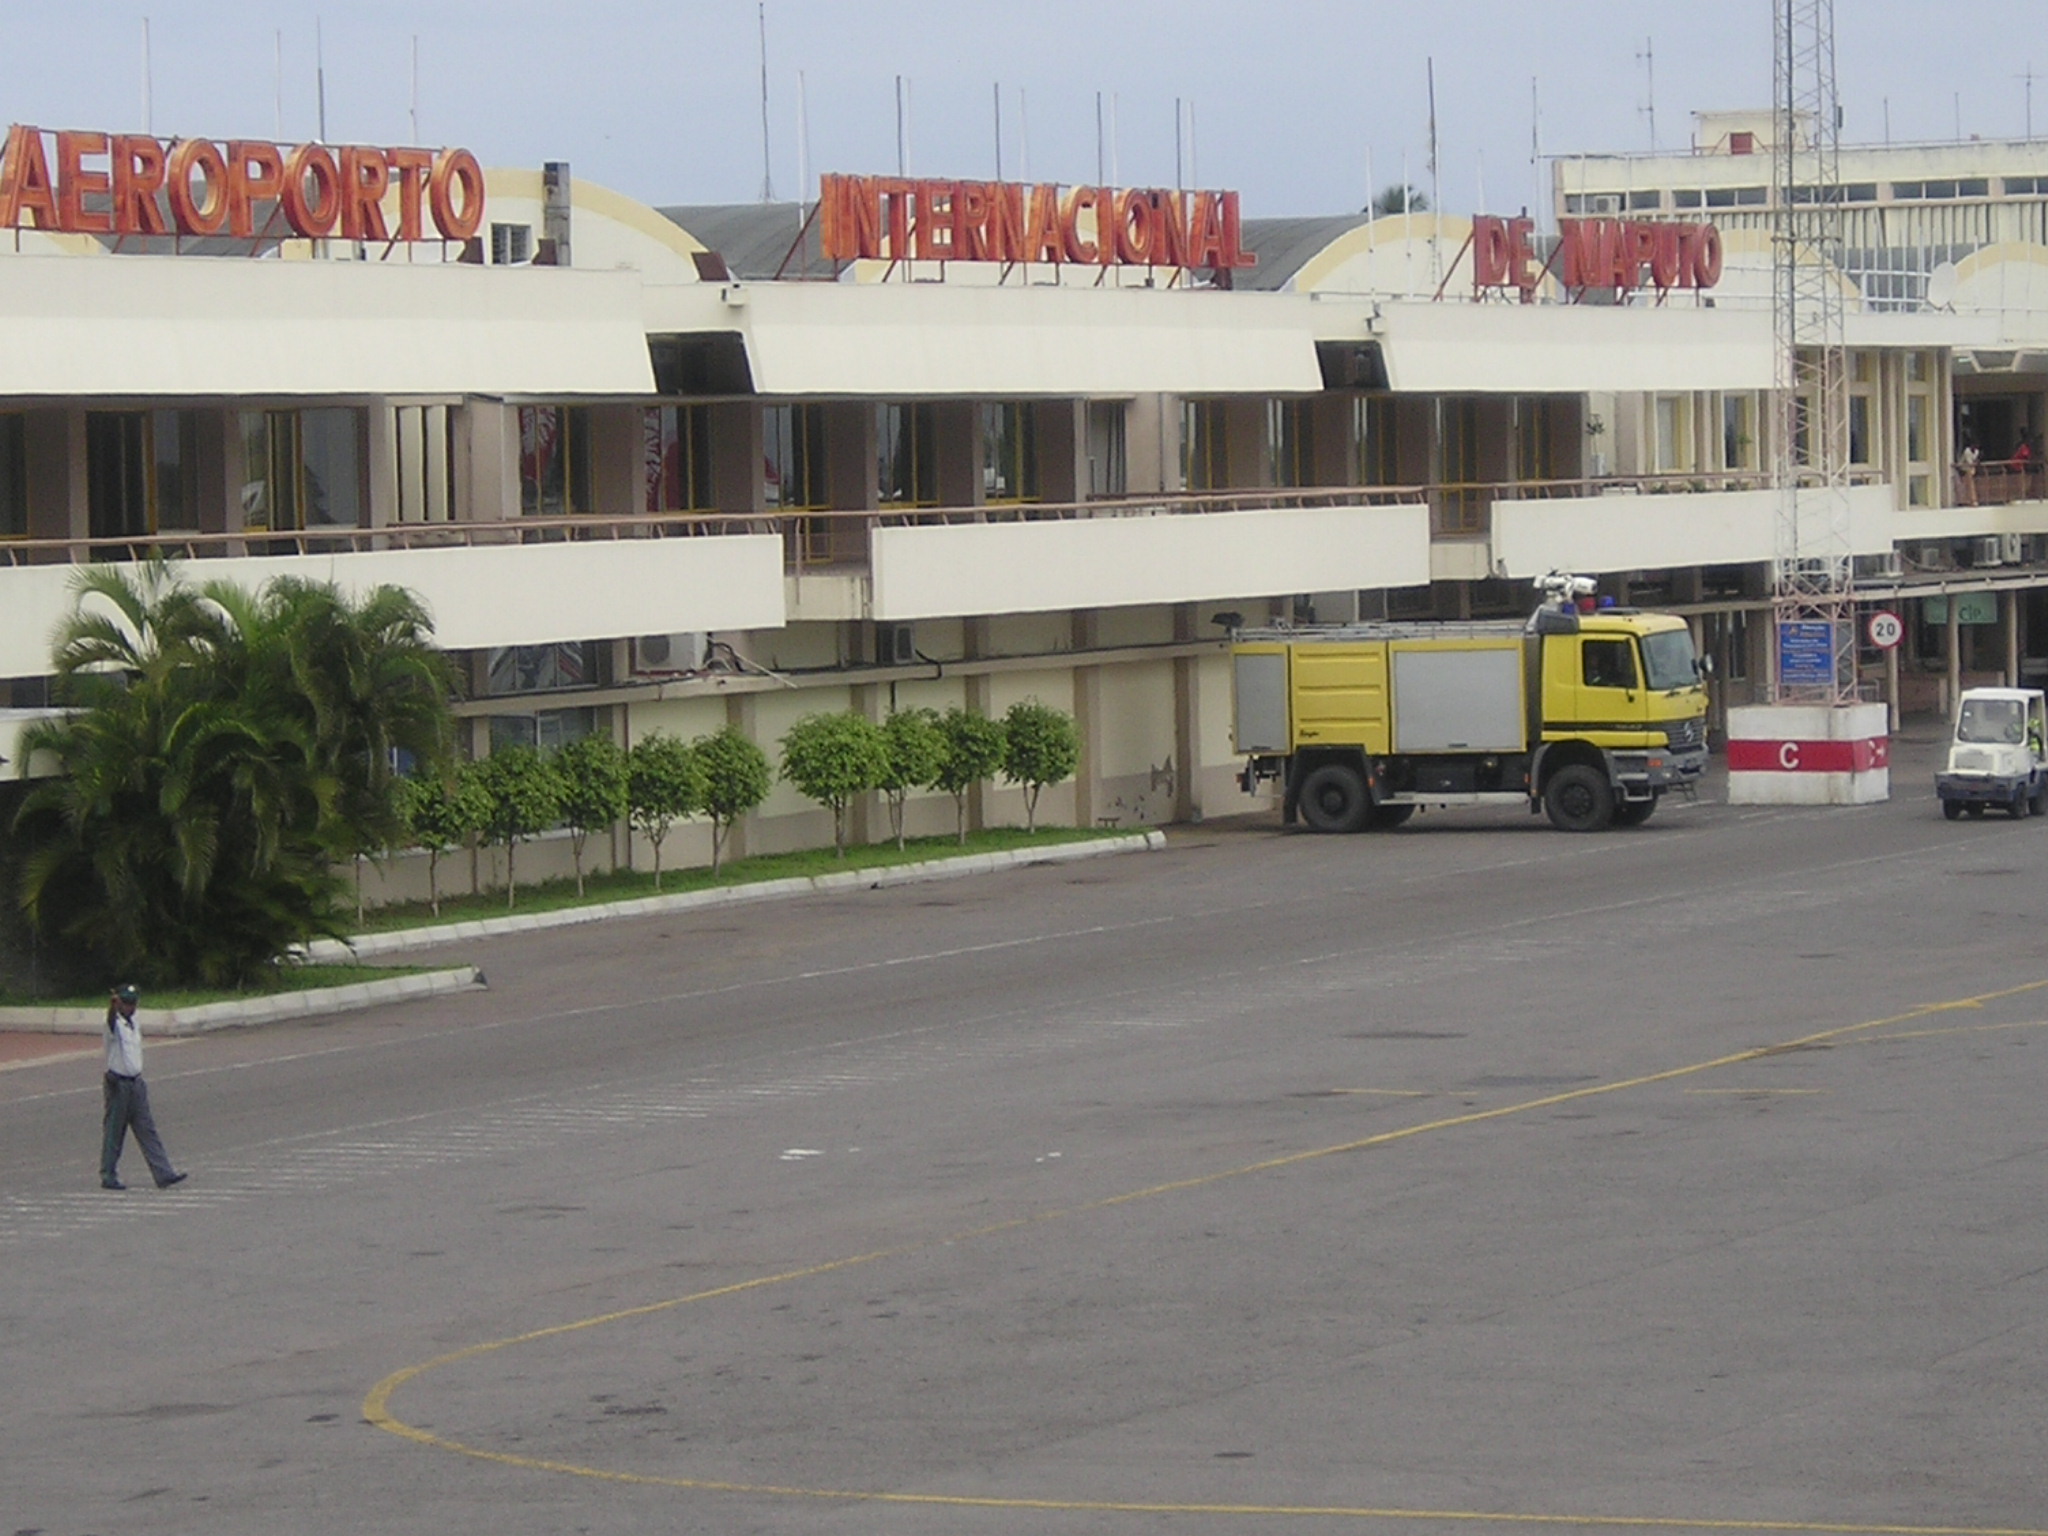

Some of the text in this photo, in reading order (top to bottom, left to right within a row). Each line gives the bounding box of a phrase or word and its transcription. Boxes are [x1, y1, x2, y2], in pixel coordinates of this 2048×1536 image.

[0, 123, 1723, 288] AEROPORTO INTERNACIONAL DE MAPUTO
[1876, 622, 1896, 637] 20
[1780, 741, 1799, 769] C
